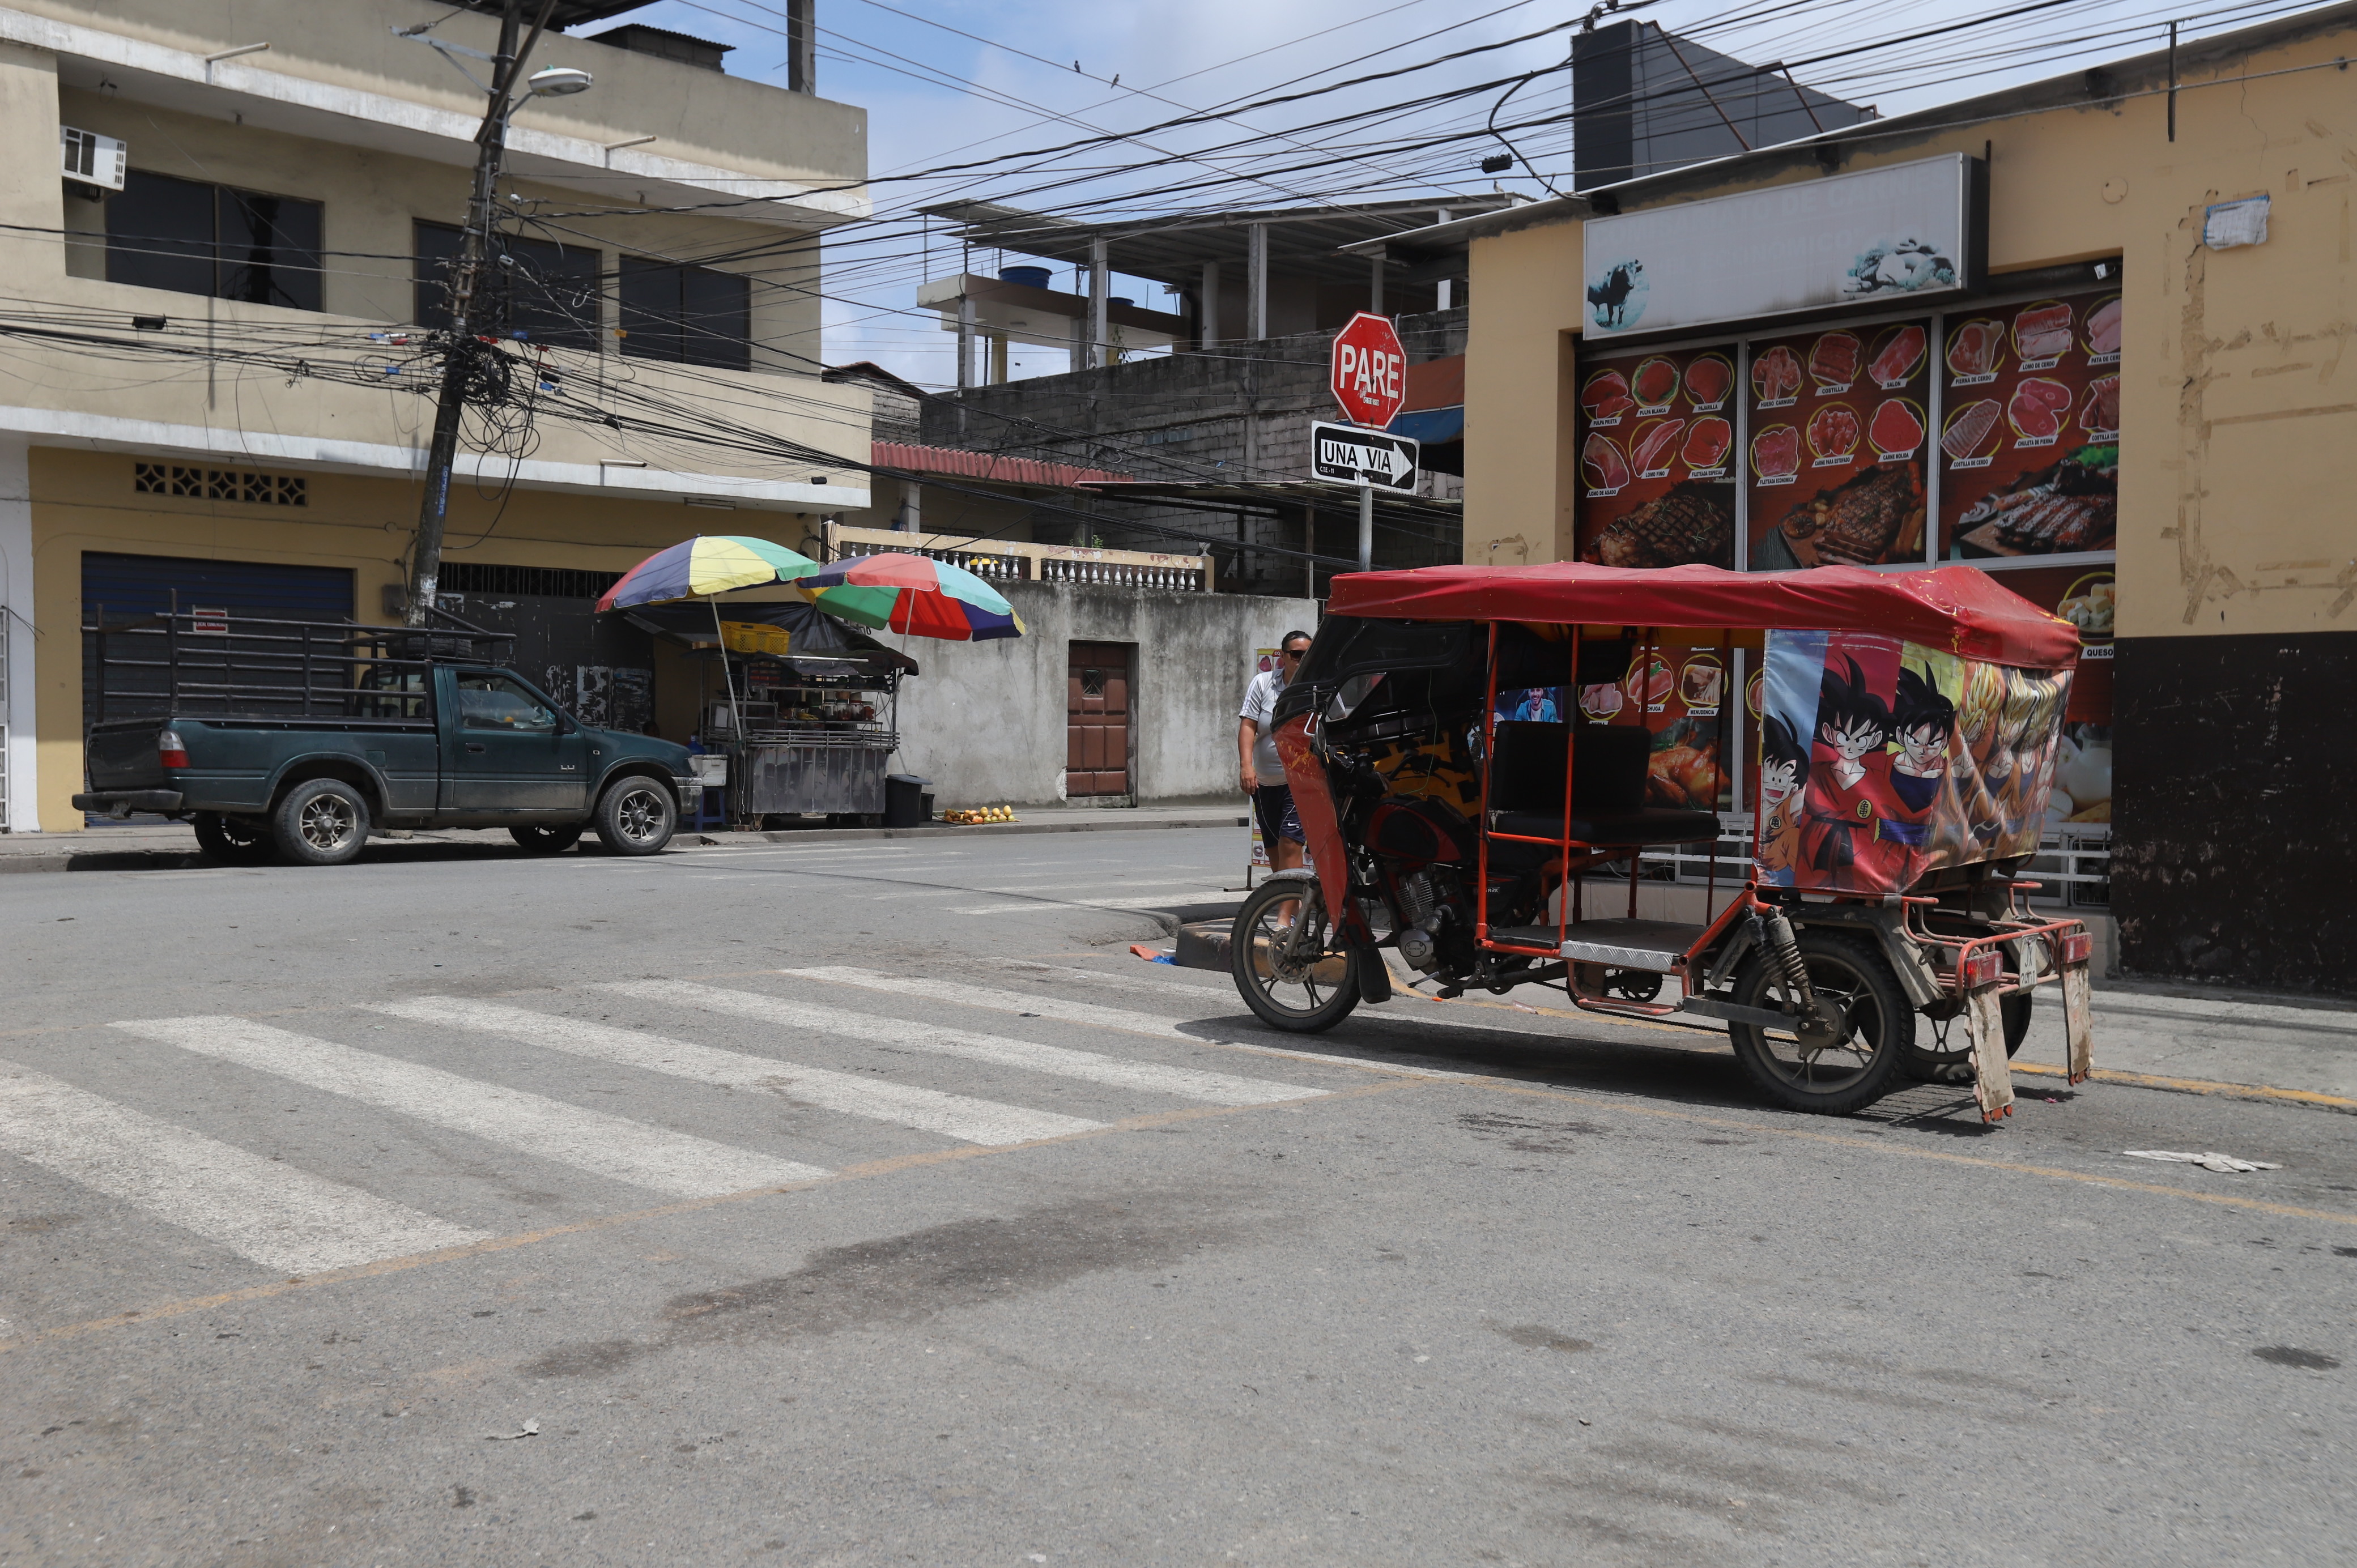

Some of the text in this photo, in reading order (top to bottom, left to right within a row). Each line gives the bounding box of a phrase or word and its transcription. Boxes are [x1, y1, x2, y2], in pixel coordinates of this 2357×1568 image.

[1339, 344, 1399, 399] PARE
[1325, 442, 1391, 472] UNA VIA
